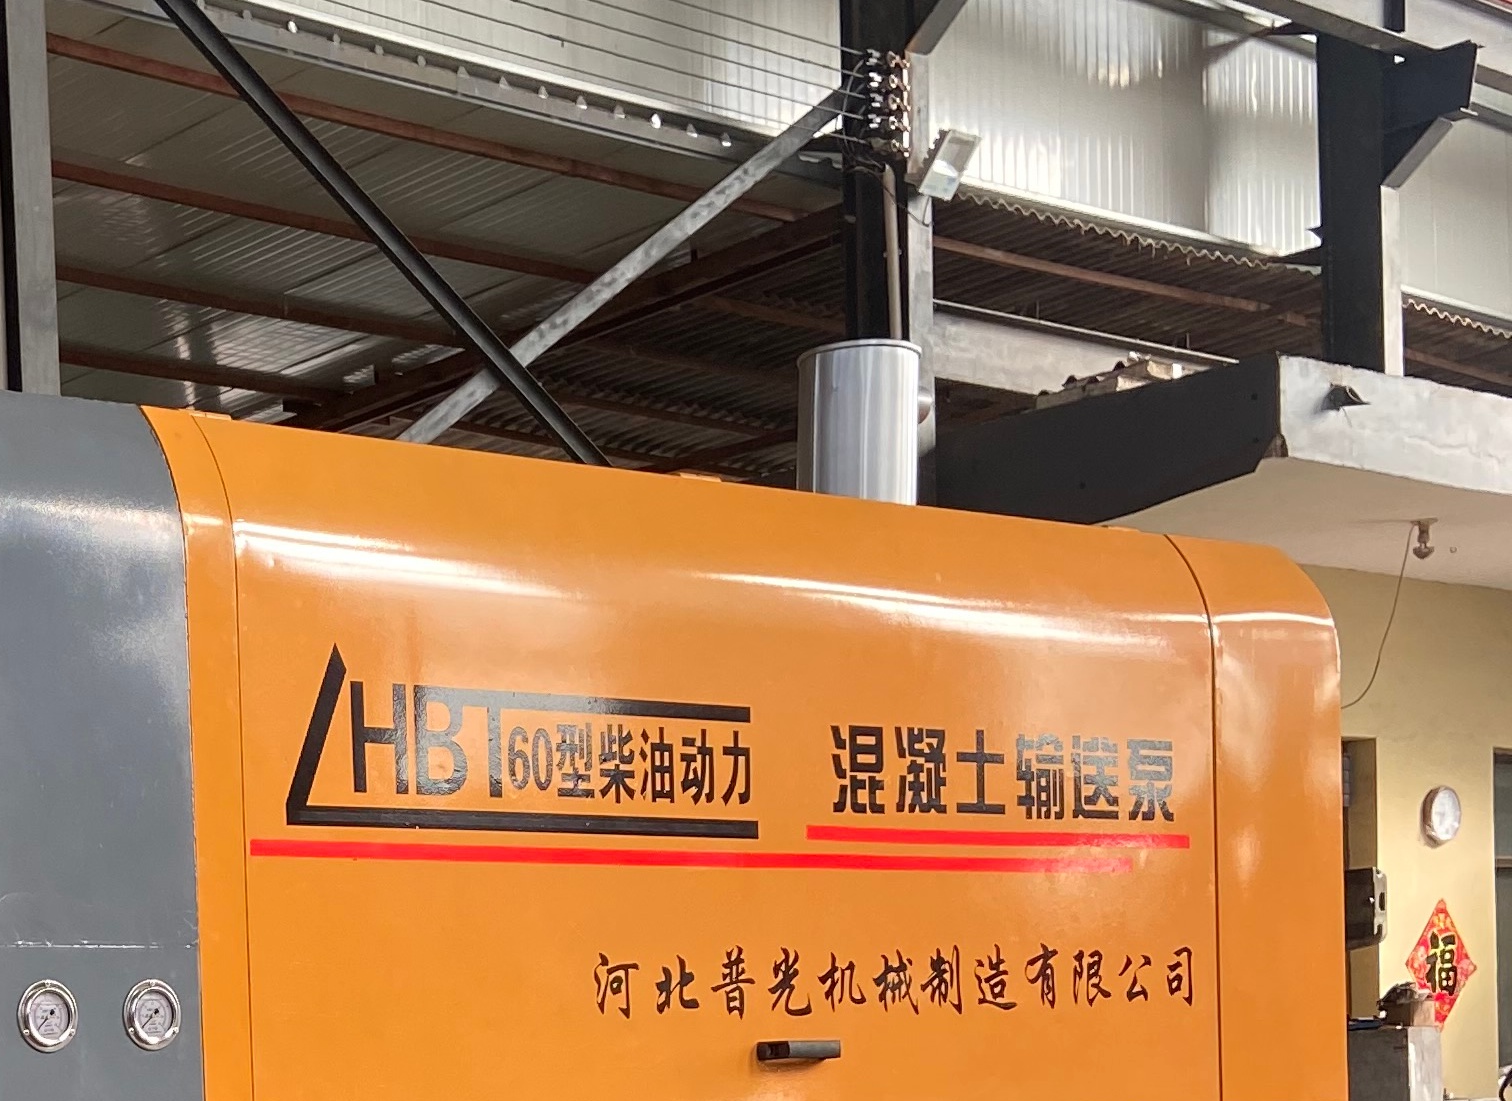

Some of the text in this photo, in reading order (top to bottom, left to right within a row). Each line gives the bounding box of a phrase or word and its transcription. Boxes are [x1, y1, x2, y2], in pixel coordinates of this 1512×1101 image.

[830, 724, 1175, 822] 混凝土输送泵
[592, 942, 1196, 1020] 河北普光机械制造有限公司
[1425, 930, 1458, 996] 福
